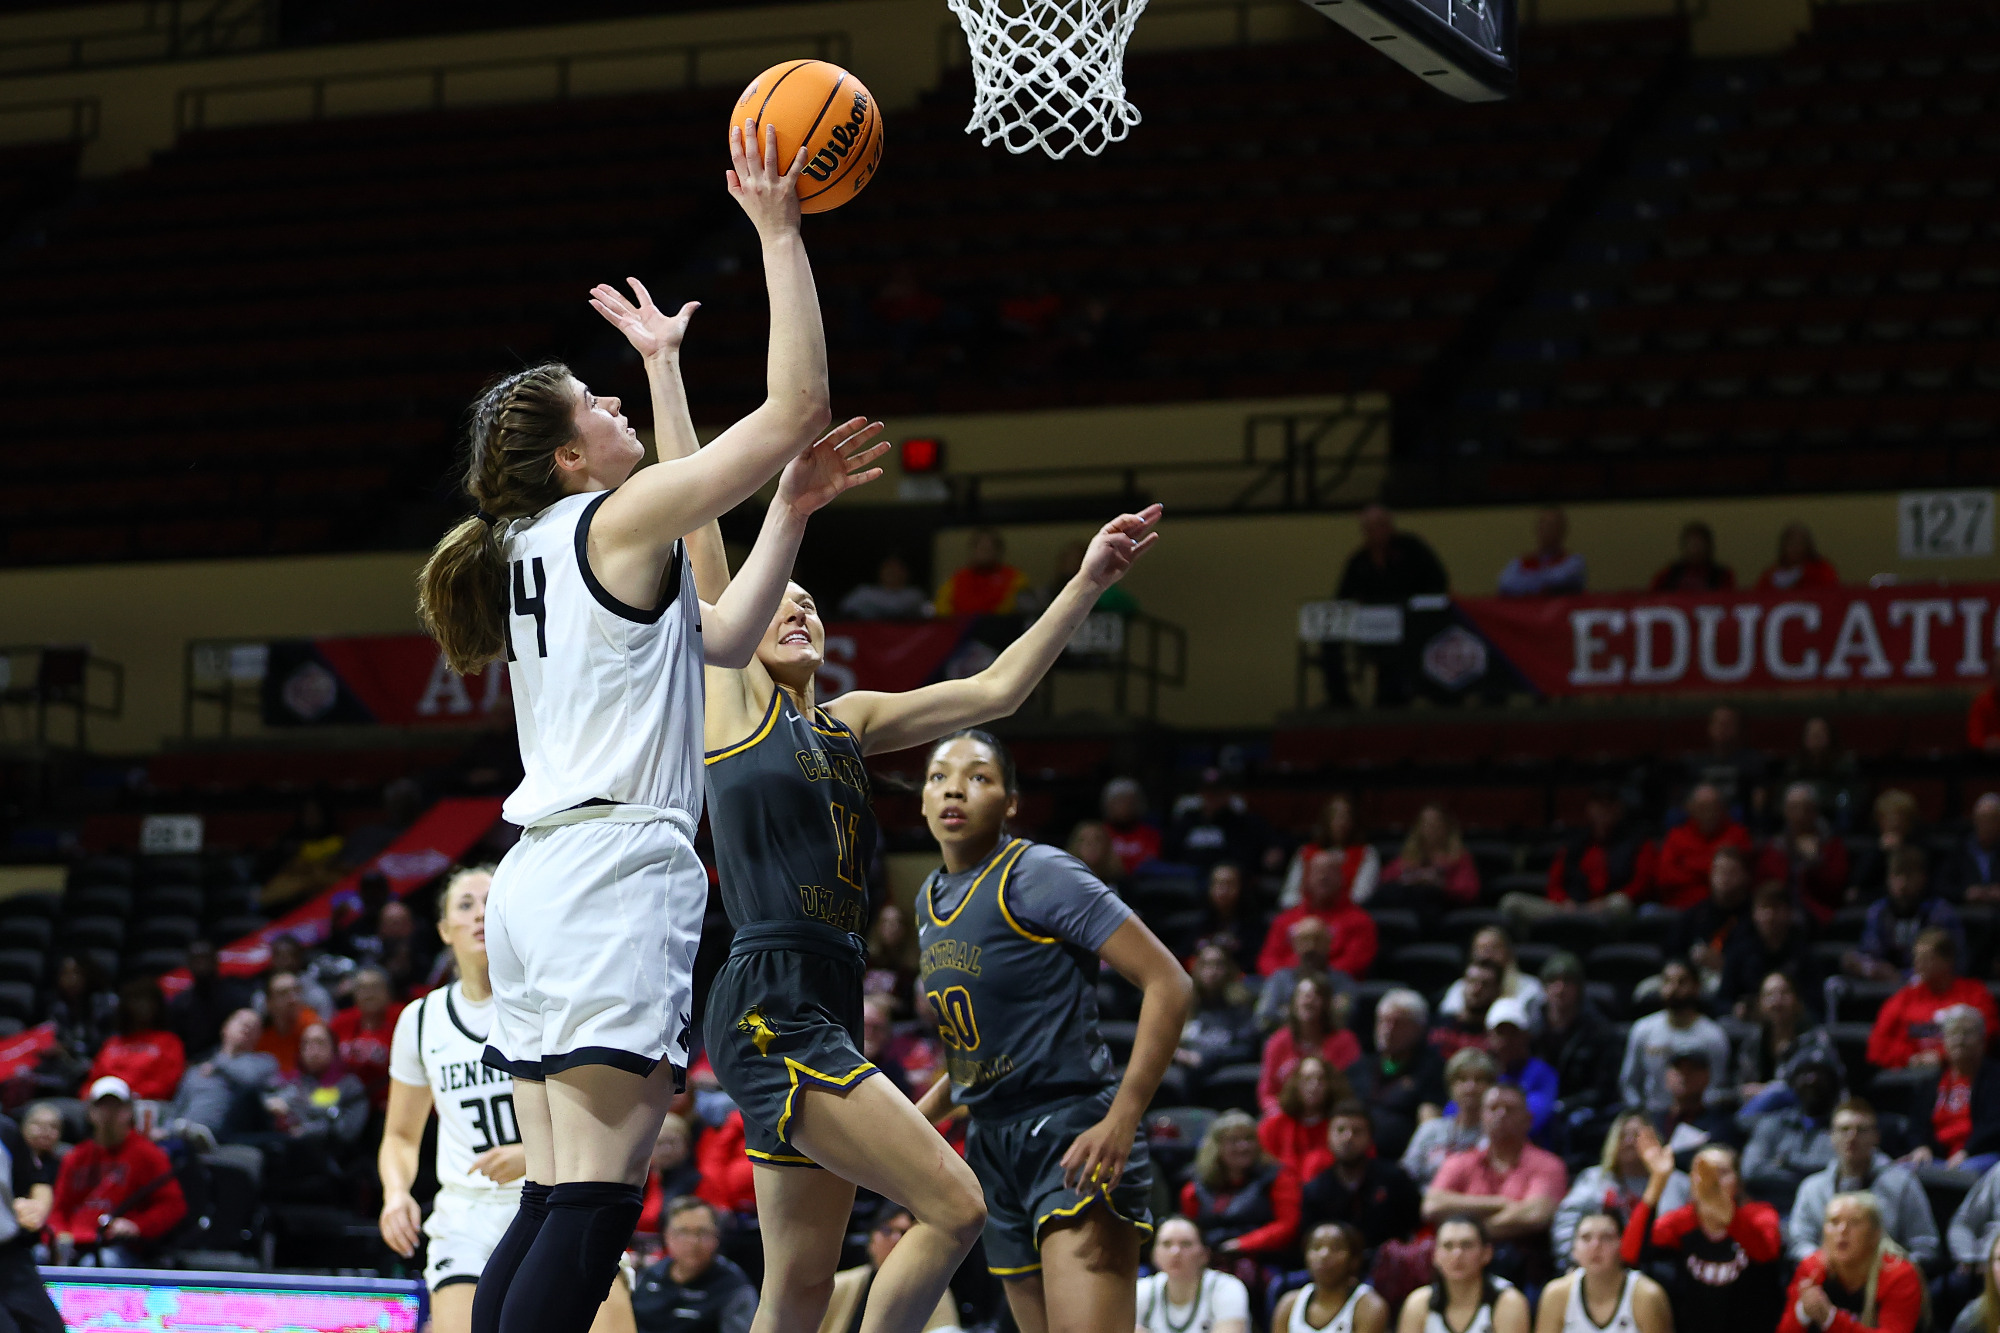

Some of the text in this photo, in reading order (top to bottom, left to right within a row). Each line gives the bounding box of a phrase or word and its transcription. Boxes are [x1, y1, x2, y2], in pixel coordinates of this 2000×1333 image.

[801, 91, 867, 181] Wilson
[1908, 498, 1986, 549] 127
[1567, 597, 2000, 686] EDUCATI
[461, 1094, 522, 1153] 30
